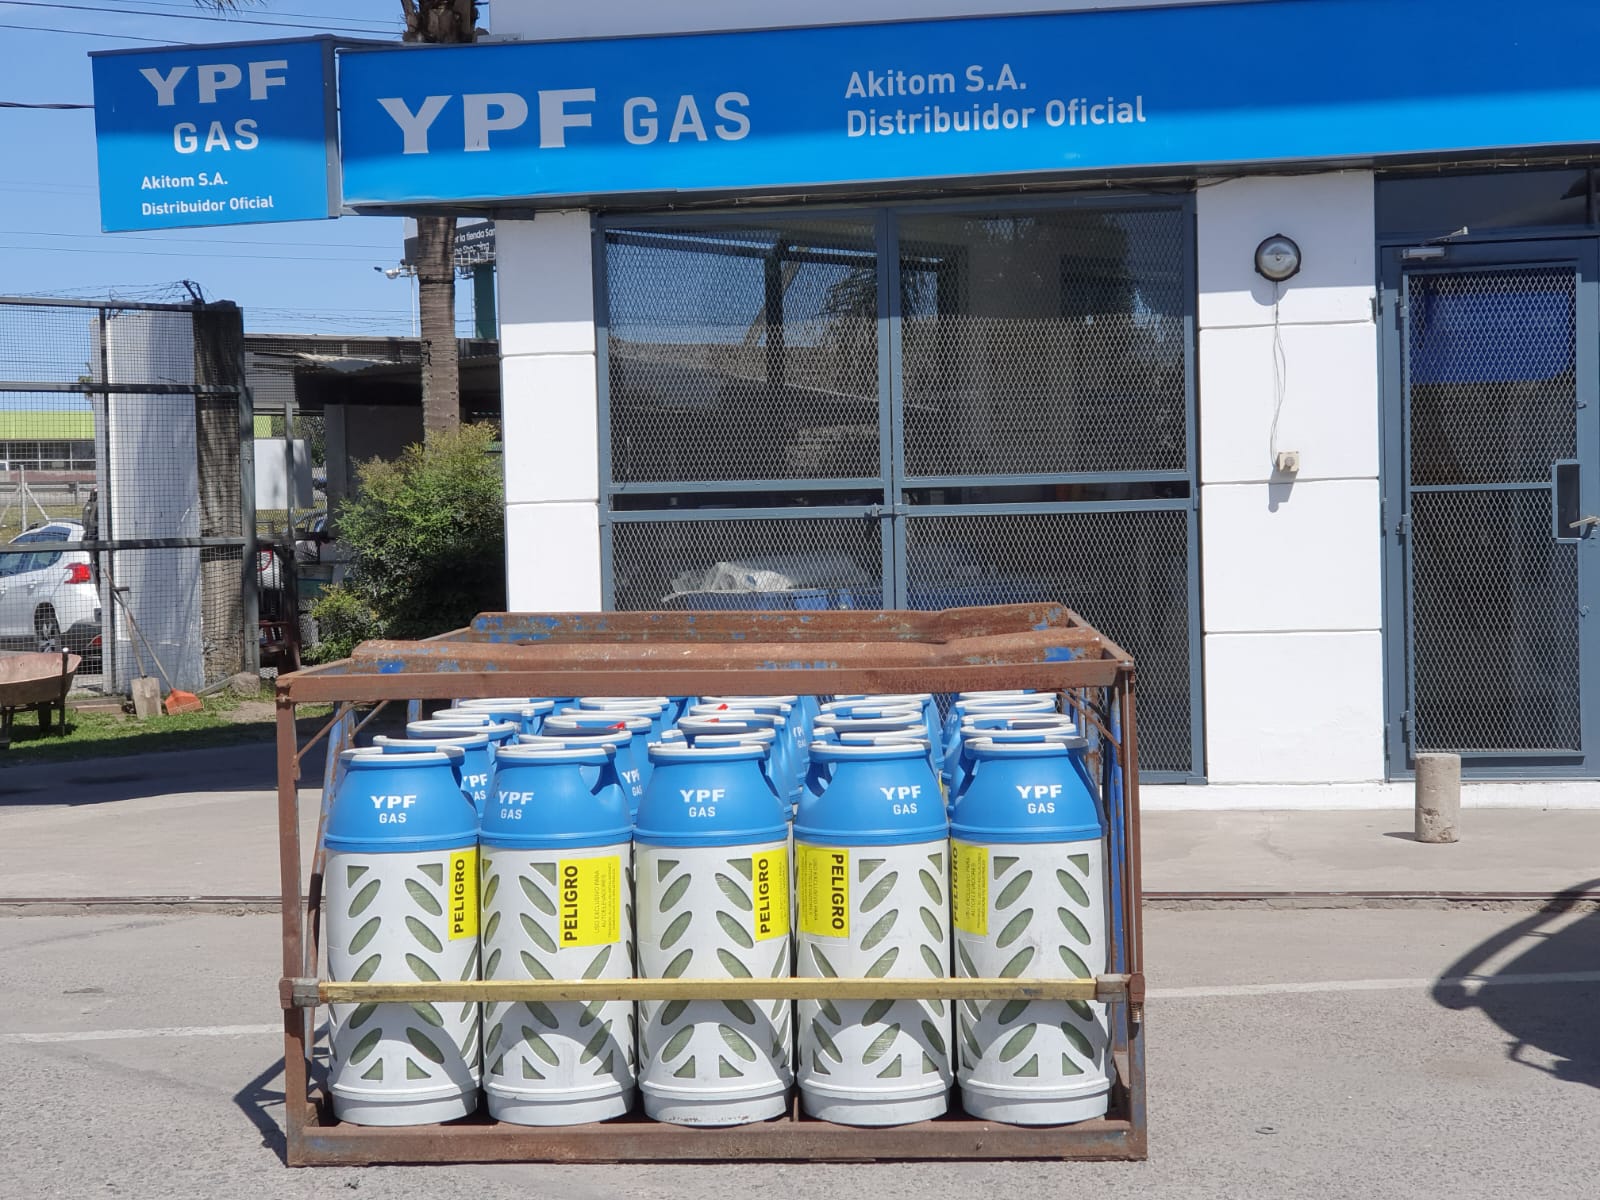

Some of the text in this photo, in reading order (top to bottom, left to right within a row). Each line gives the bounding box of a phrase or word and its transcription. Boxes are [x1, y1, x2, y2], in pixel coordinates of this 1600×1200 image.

[139, 59, 288, 106] YPF
[845, 63, 1027, 99] Akitom S.A.
[377, 87, 751, 155] YPF GAS
[847, 95, 1147, 137] Distribuidor Oficial
[173, 118, 259, 154] GAS
[141, 172, 228, 190] Akitom S.A.
[142, 195, 274, 215] Distribuidor Oficial
[473, 790, 487, 801] AS
[498, 791, 535, 806] YPF
[680, 788, 725, 802] YPF
[879, 785, 921, 800] YPF
[1015, 784, 1062, 799] YPF
[371, 794, 417, 809] YPF
[893, 803, 918, 815] GAS
[1027, 802, 1055, 814] GAS
[379, 812, 407, 824] GAS
[500, 808, 522, 820] GAS
[688, 806, 716, 817] GAS
[454, 859, 466, 934] PELIGRO
[758, 858, 772, 934] PELIGRO
[831, 854, 845, 930] PELIGRO
[564, 865, 578, 941] PELIGRO
